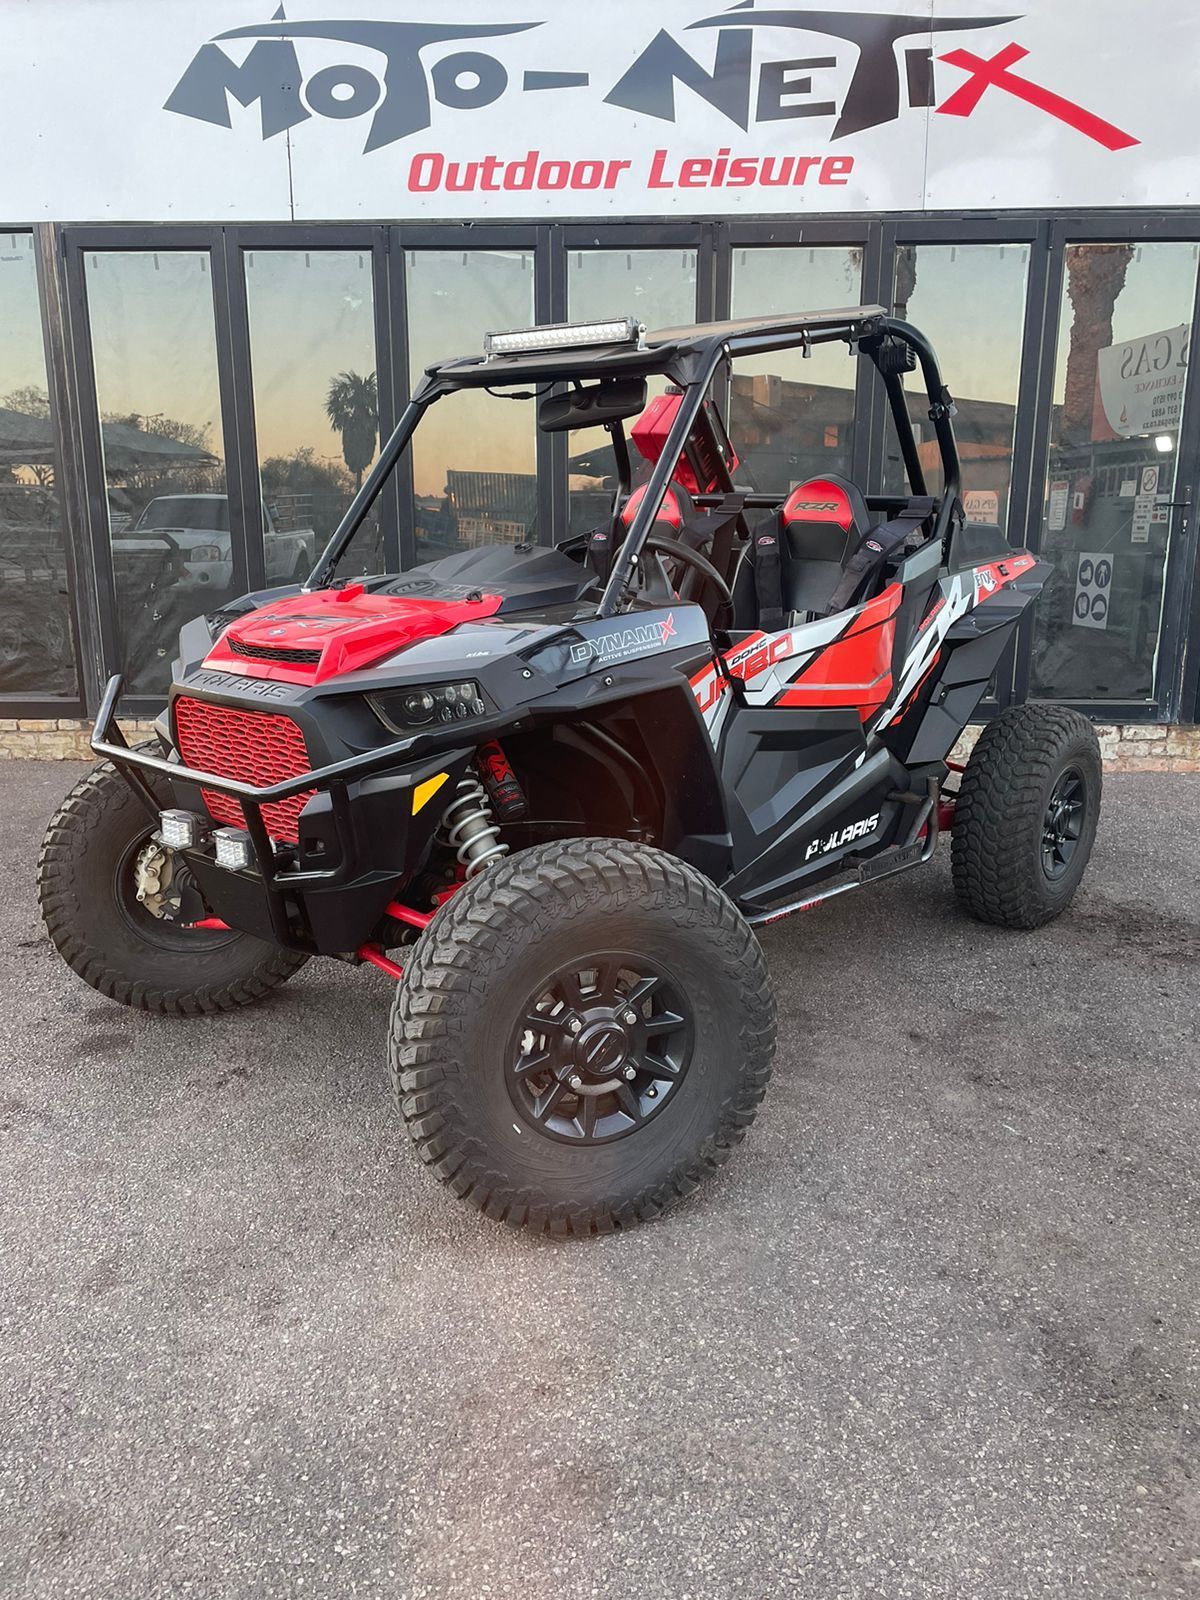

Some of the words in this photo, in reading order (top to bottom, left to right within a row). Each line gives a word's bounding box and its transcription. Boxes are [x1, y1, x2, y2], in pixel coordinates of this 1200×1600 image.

[407, 150, 631, 192] Outdoor
[648, 148, 855, 189] Leisure
[794, 502, 839, 512] RZR
[974, 570, 990, 586] FOX
[570, 612, 677, 663] DYNAMIX
[598, 652, 622, 663] ACTIVE
[623, 641, 662, 657] SUSPENSION
[731, 639, 767, 665] DOHC
[188, 673, 294, 698] POLARIS
[805, 813, 880, 860] POLARIS
